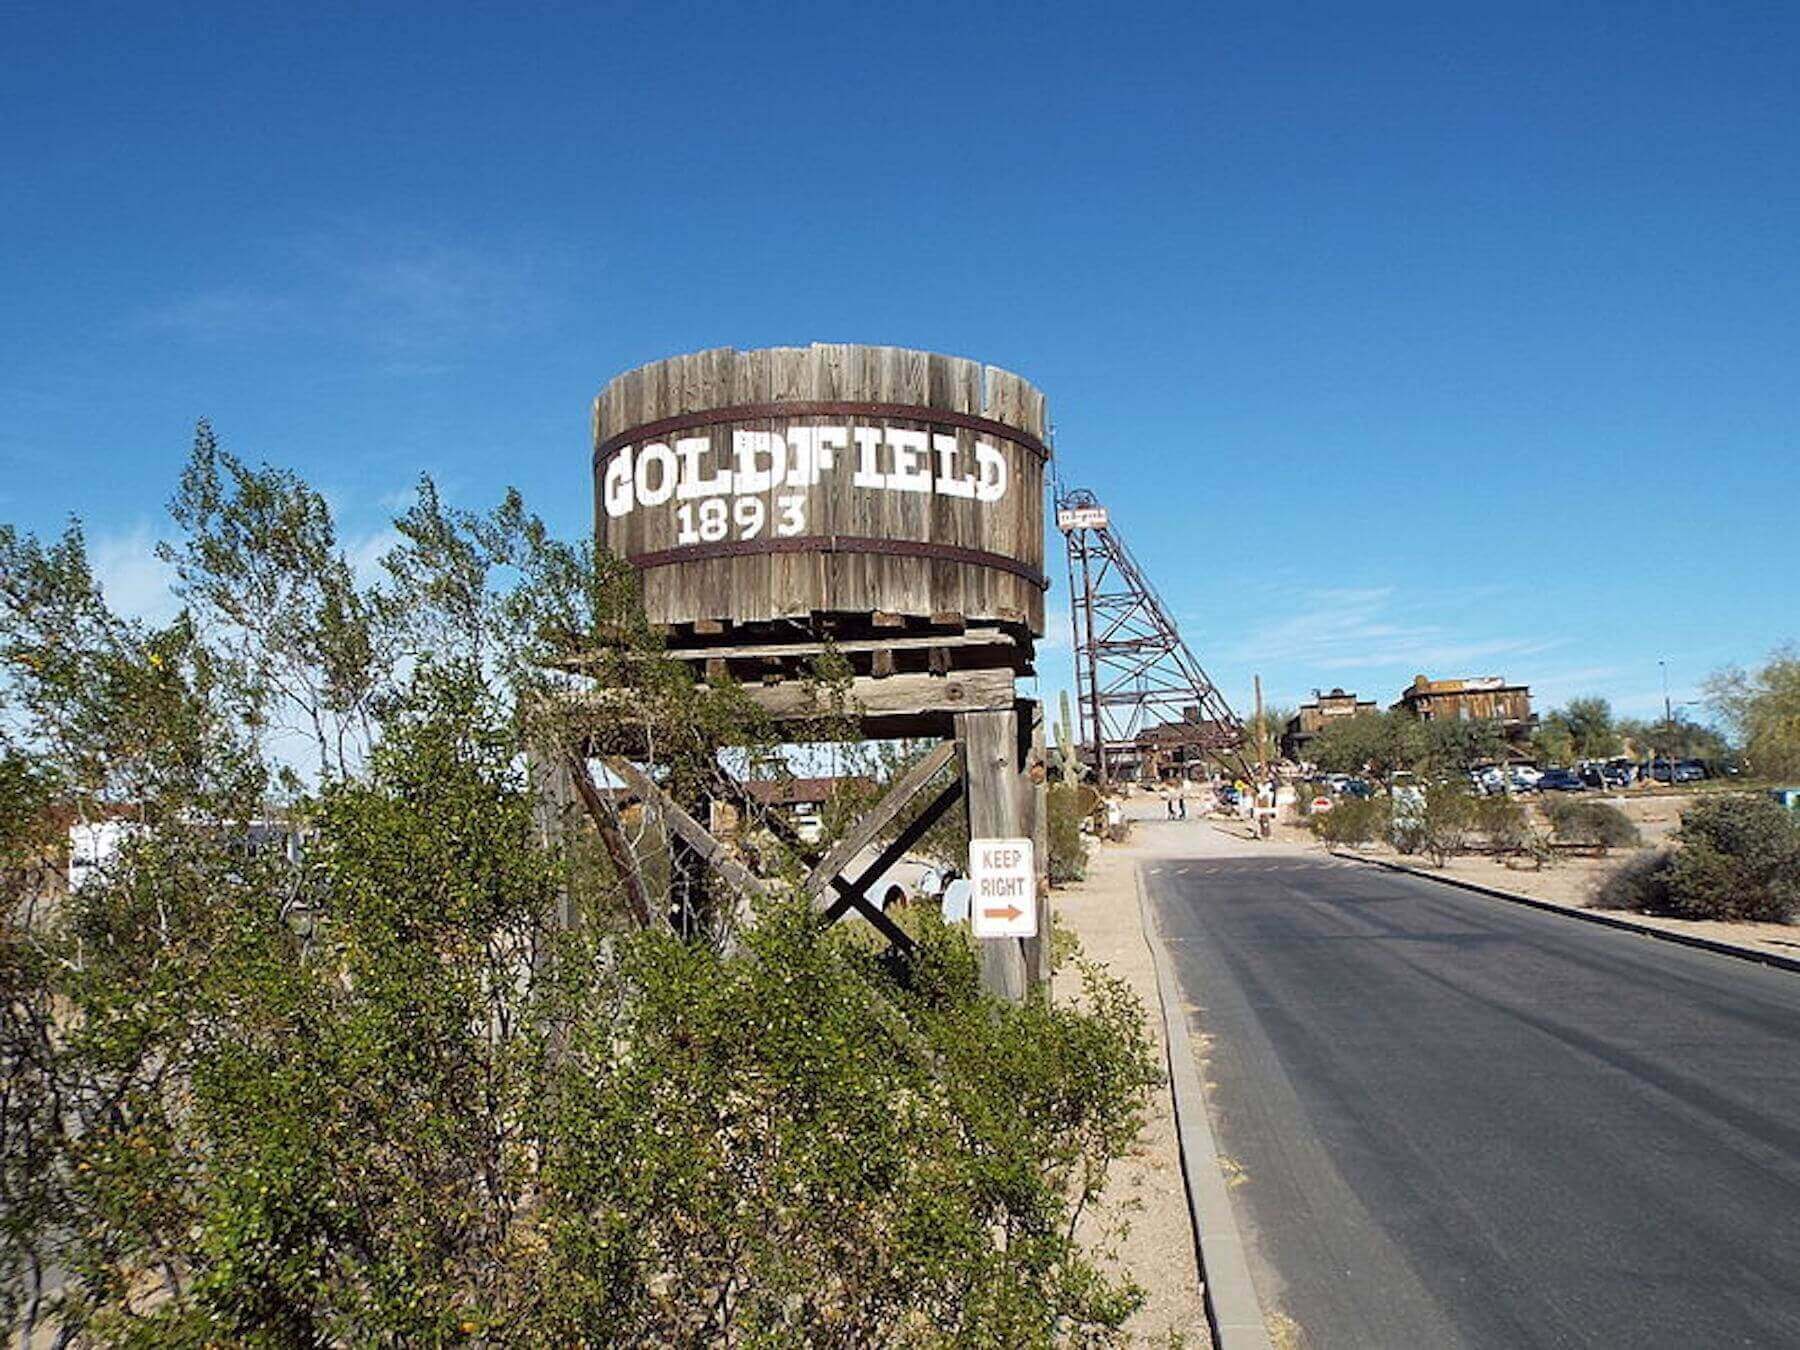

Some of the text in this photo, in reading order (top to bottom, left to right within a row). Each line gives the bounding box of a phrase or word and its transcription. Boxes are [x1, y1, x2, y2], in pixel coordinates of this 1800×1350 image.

[604, 426, 1007, 518] GOLDFIELD
[677, 495, 808, 545] 1893
[982, 849, 1022, 869] KEEP
[980, 877, 1025, 897] RIGHT
